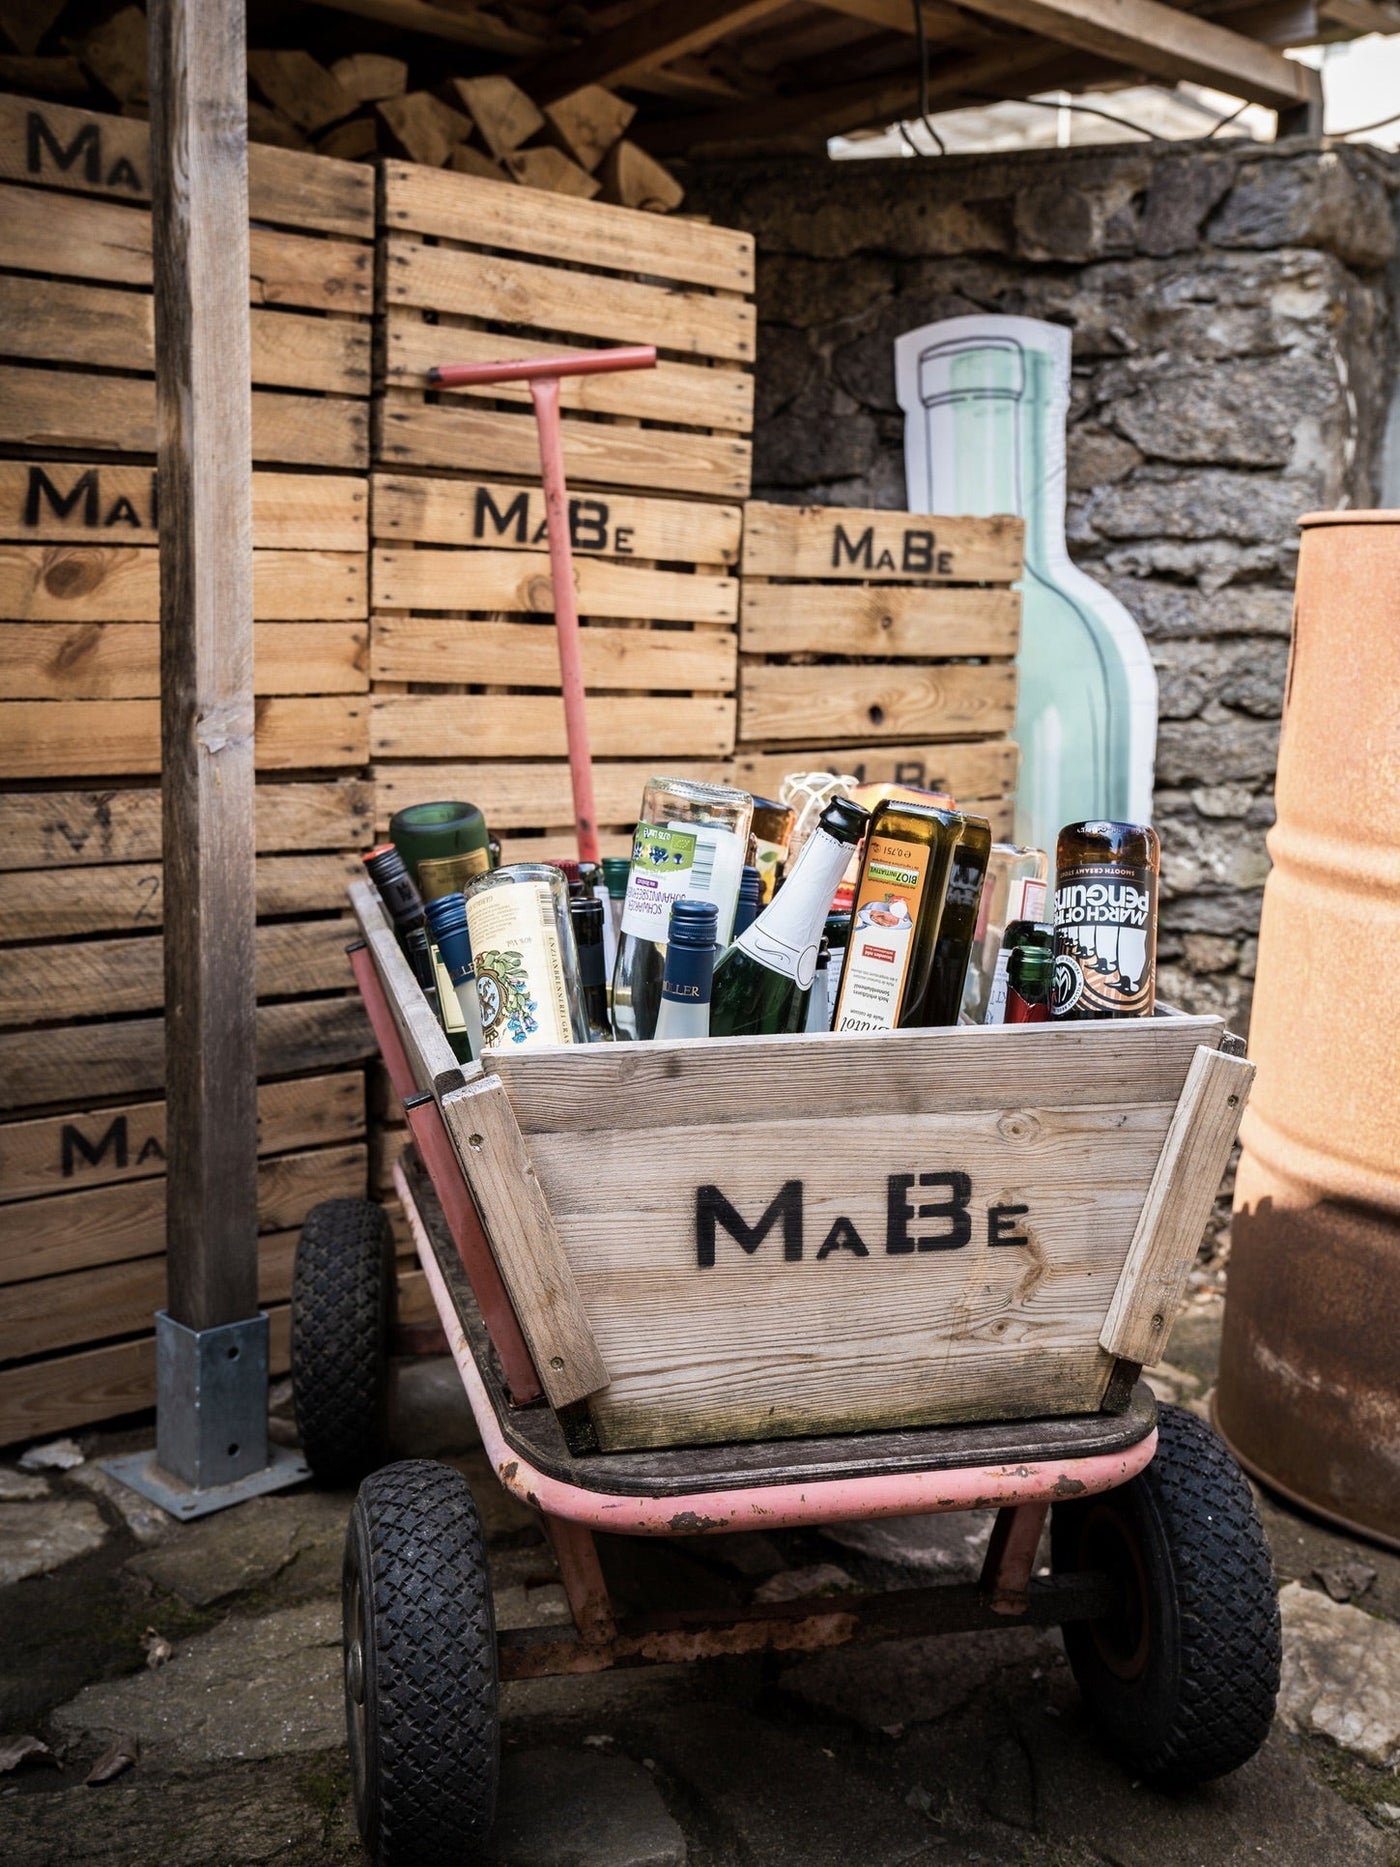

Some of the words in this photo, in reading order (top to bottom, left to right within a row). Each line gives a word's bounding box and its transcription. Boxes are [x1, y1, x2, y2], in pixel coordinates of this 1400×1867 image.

[26, 111, 142, 191] MA
[1075, 867, 1103, 877] CREAMY
[1104, 867, 1135, 876] SMOOTH
[1068, 906, 1085, 923] OF
[1086, 906, 1148, 926] MARCH
[61, 1114, 168, 1178] MA
